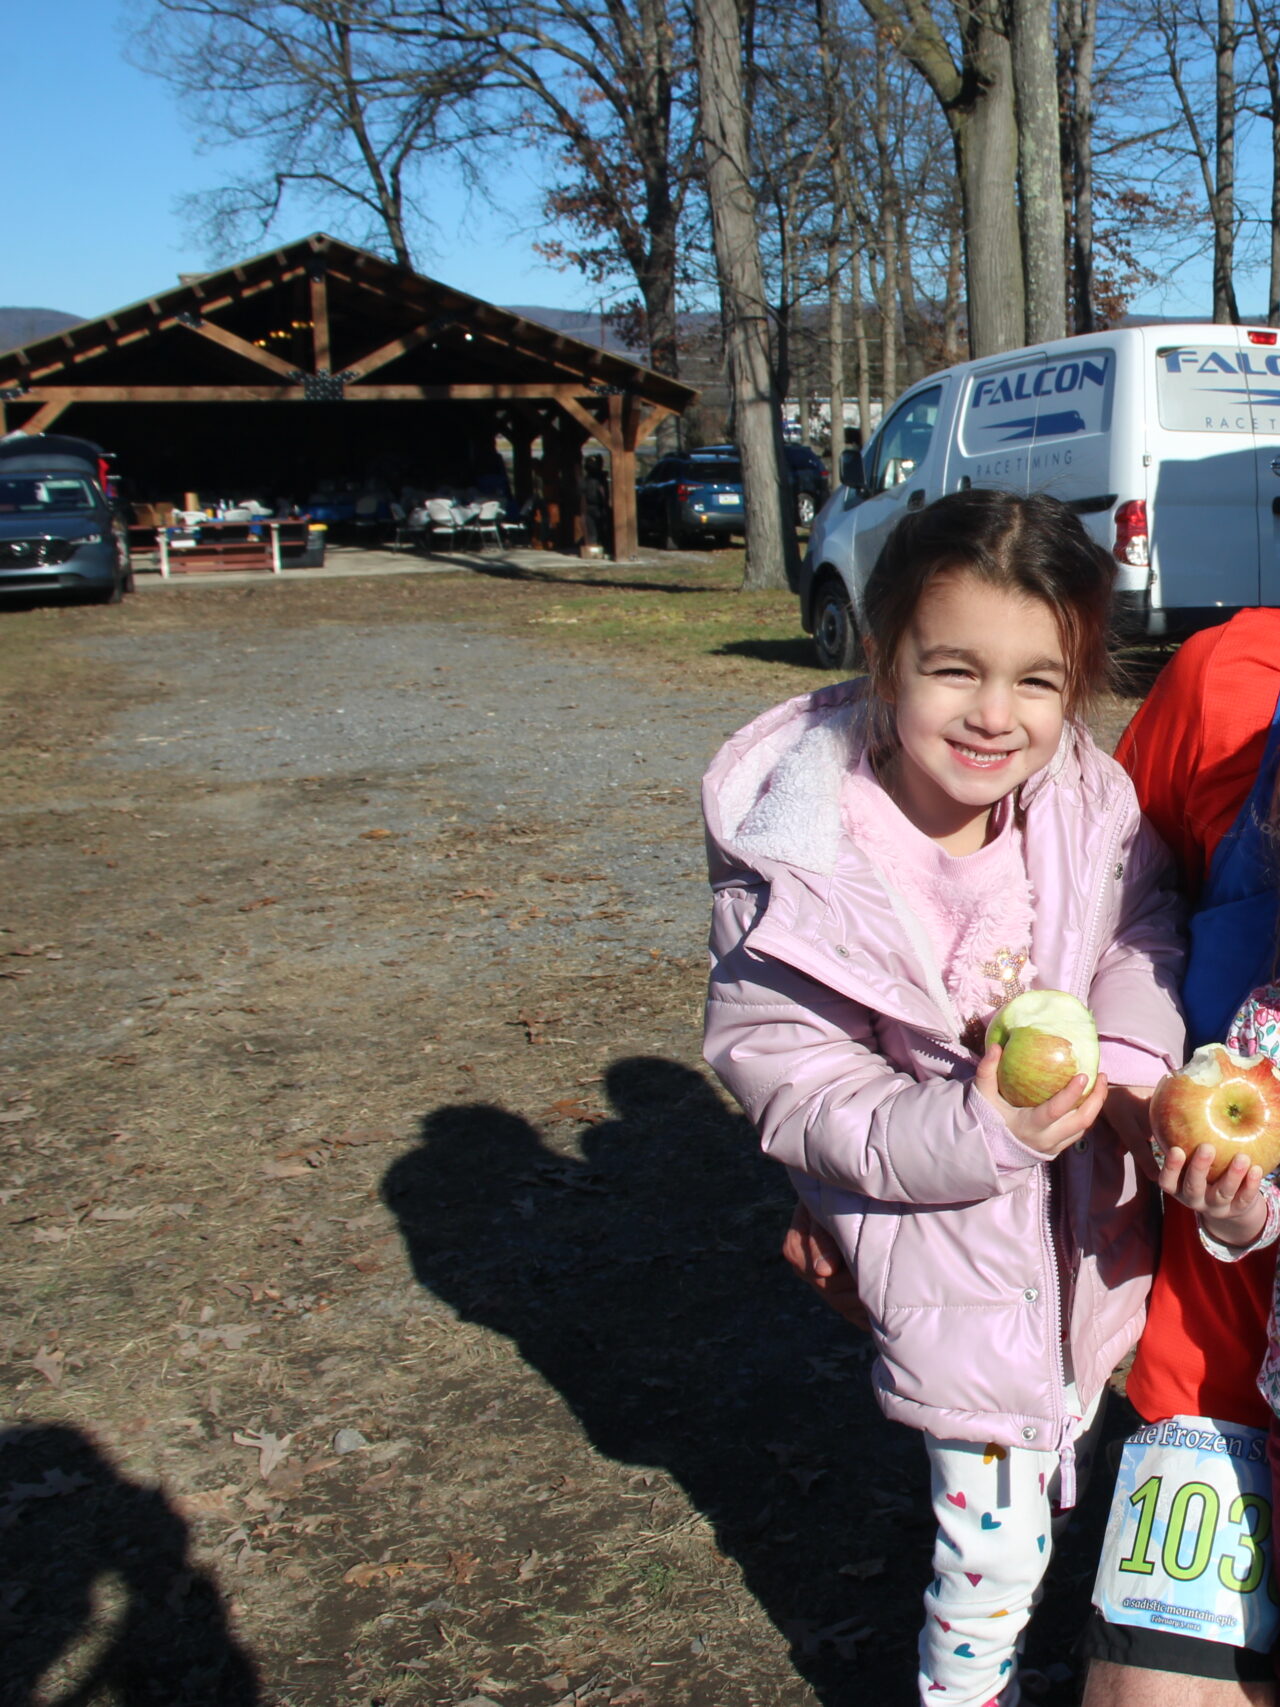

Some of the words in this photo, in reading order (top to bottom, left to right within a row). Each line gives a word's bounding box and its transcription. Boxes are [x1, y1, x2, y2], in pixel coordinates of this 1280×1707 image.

[971, 356, 1109, 409] FALCON
[1205, 416, 1260, 430] RACE
[976, 459, 1010, 477] RACE
[1016, 449, 1073, 472] TIMING
[1158, 1421, 1243, 1458] Frozen
[1118, 1475, 1274, 1595] 103
[1130, 1598, 1167, 1613] sadistic
[1166, 1604, 1215, 1622] mountain
[1215, 1613, 1237, 1627] epic
